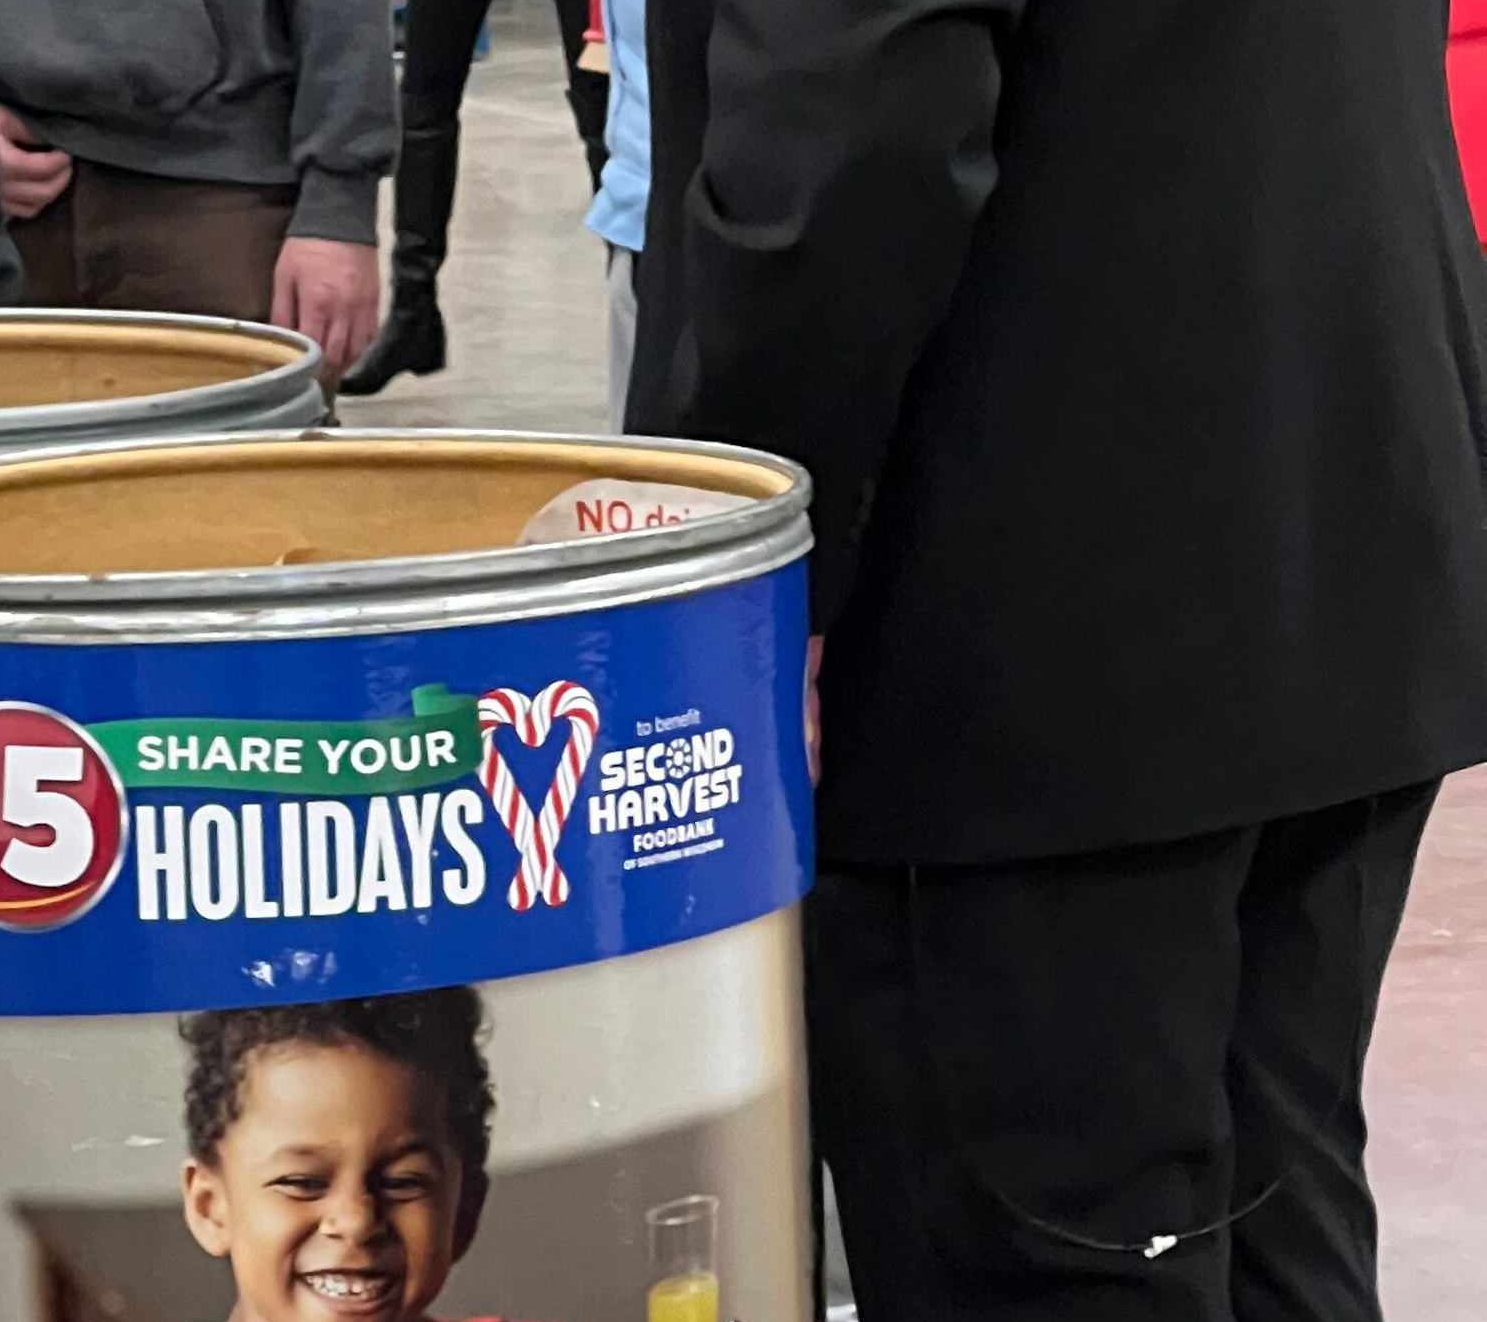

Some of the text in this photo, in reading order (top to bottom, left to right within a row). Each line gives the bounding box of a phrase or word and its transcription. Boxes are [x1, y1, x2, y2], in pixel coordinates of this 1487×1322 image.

[575, 499, 634, 533] NO
[137, 729, 458, 776] SHARE YOUR
[599, 727, 735, 792] SECOND
[588, 764, 743, 835] HARVEST
[134, 788, 487, 922] HOLIDAYS
